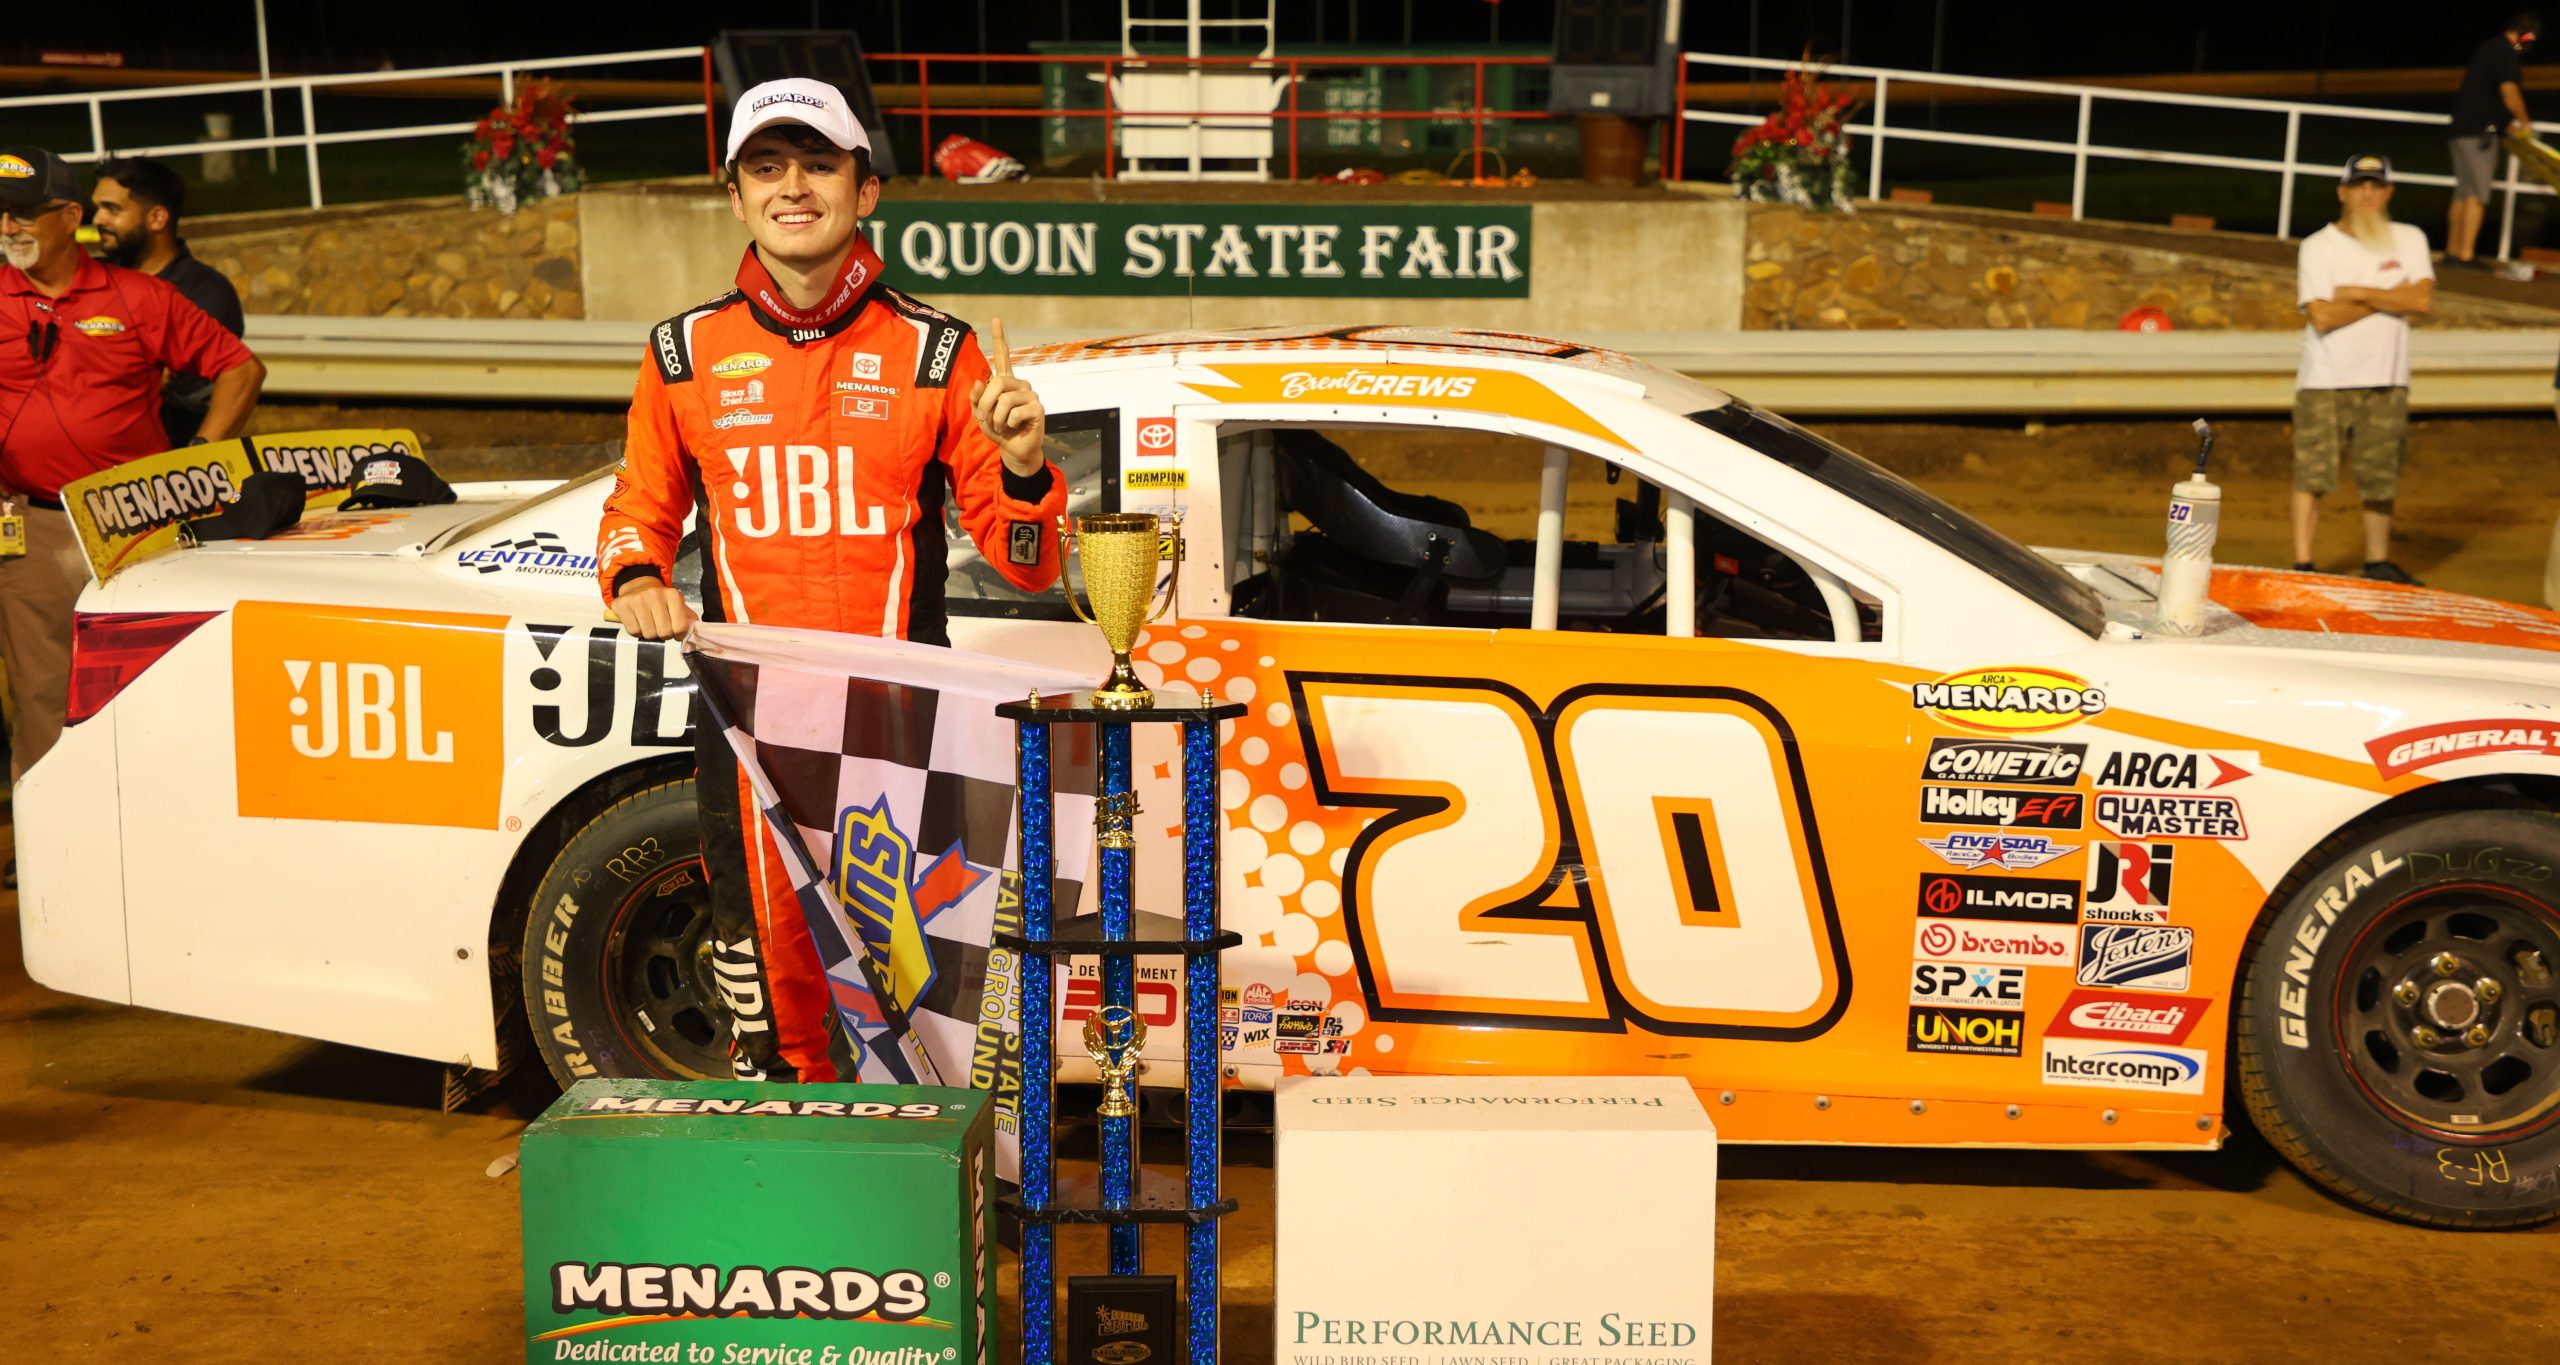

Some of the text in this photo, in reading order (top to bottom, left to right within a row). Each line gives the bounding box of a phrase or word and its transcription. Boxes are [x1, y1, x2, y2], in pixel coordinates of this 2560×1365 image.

[752, 93, 825, 112] MENARDS
[900, 220, 1097, 280] QUOIN
[1123, 223, 1344, 279] STATE
[1358, 224, 1523, 283] FAIR
[760, 289, 823, 325] GENERAL
[824, 285, 852, 316] TIRE
[657, 322, 682, 377] sparco
[929, 327, 958, 381] sparco
[712, 358, 773, 374] MENARDS
[836, 381, 897, 395] MENARDS
[1280, 369, 1477, 399] Brent CREWS
[264, 443, 410, 491] MENA
[1129, 472, 1185, 483] CHAMPION
[85, 461, 236, 540] MENARDS
[725, 445, 887, 537] JBL
[2169, 504, 2190, 521] 20
[457, 551, 598, 570] VENTURI
[515, 566, 598, 579] MOTORSPOR
[525, 623, 698, 748] JB
[1980, 674, 2006, 684] ARCA
[283, 659, 454, 763] JBL
[1914, 682, 2106, 715] MENARDS
[1928, 747, 2081, 779] COMETIC
[2387, 728, 2548, 768] GENERAL
[1937, 773, 1995, 781] GASKET
[2096, 751, 2197, 789] ARCA
[1926, 787, 2018, 826] Holley
[2098, 796, 2234, 823] QUARTER
[2121, 815, 2239, 836] MASTER
[1284, 671, 1852, 1042] 20
[1947, 835, 2048, 854] FIVE STAR
[2007, 853, 2039, 861] Bodies
[1966, 889, 2074, 910] ILMOR
[2086, 908, 2155, 922] shocks
[1962, 931, 2066, 956] brembo
[2077, 924, 2193, 986] Jostens
[2279, 849, 2404, 1049] GENERAL
[542, 893, 598, 1078] RABBER
[1080, 965, 1178, 981] DEMENT
[1243, 1011, 1268, 1021] TORK
[1287, 1000, 1323, 1013] ICON
[2069, 1001, 2186, 1035] Eibach
[1244, 1028, 1271, 1044] WIX
[1279, 1023, 1314, 1032] TINTING
[1916, 1012, 2021, 1047] UNOH
[2046, 1051, 2180, 1087] Intercomp
[588, 1096, 942, 1119] MENARDS
[1312, 1096, 1664, 1107] PERFORMANCE SEED
[974, 1146, 986, 1365] MENA
[553, 1263, 928, 1318] MENARDS
[1294, 1310, 1696, 1347] PERFORMANCE SEED
[555, 1339, 680, 1363] Dedicated
[687, 1342, 715, 1364] to
[722, 1343, 813, 1365] Service
[822, 1347, 842, 1365] &
